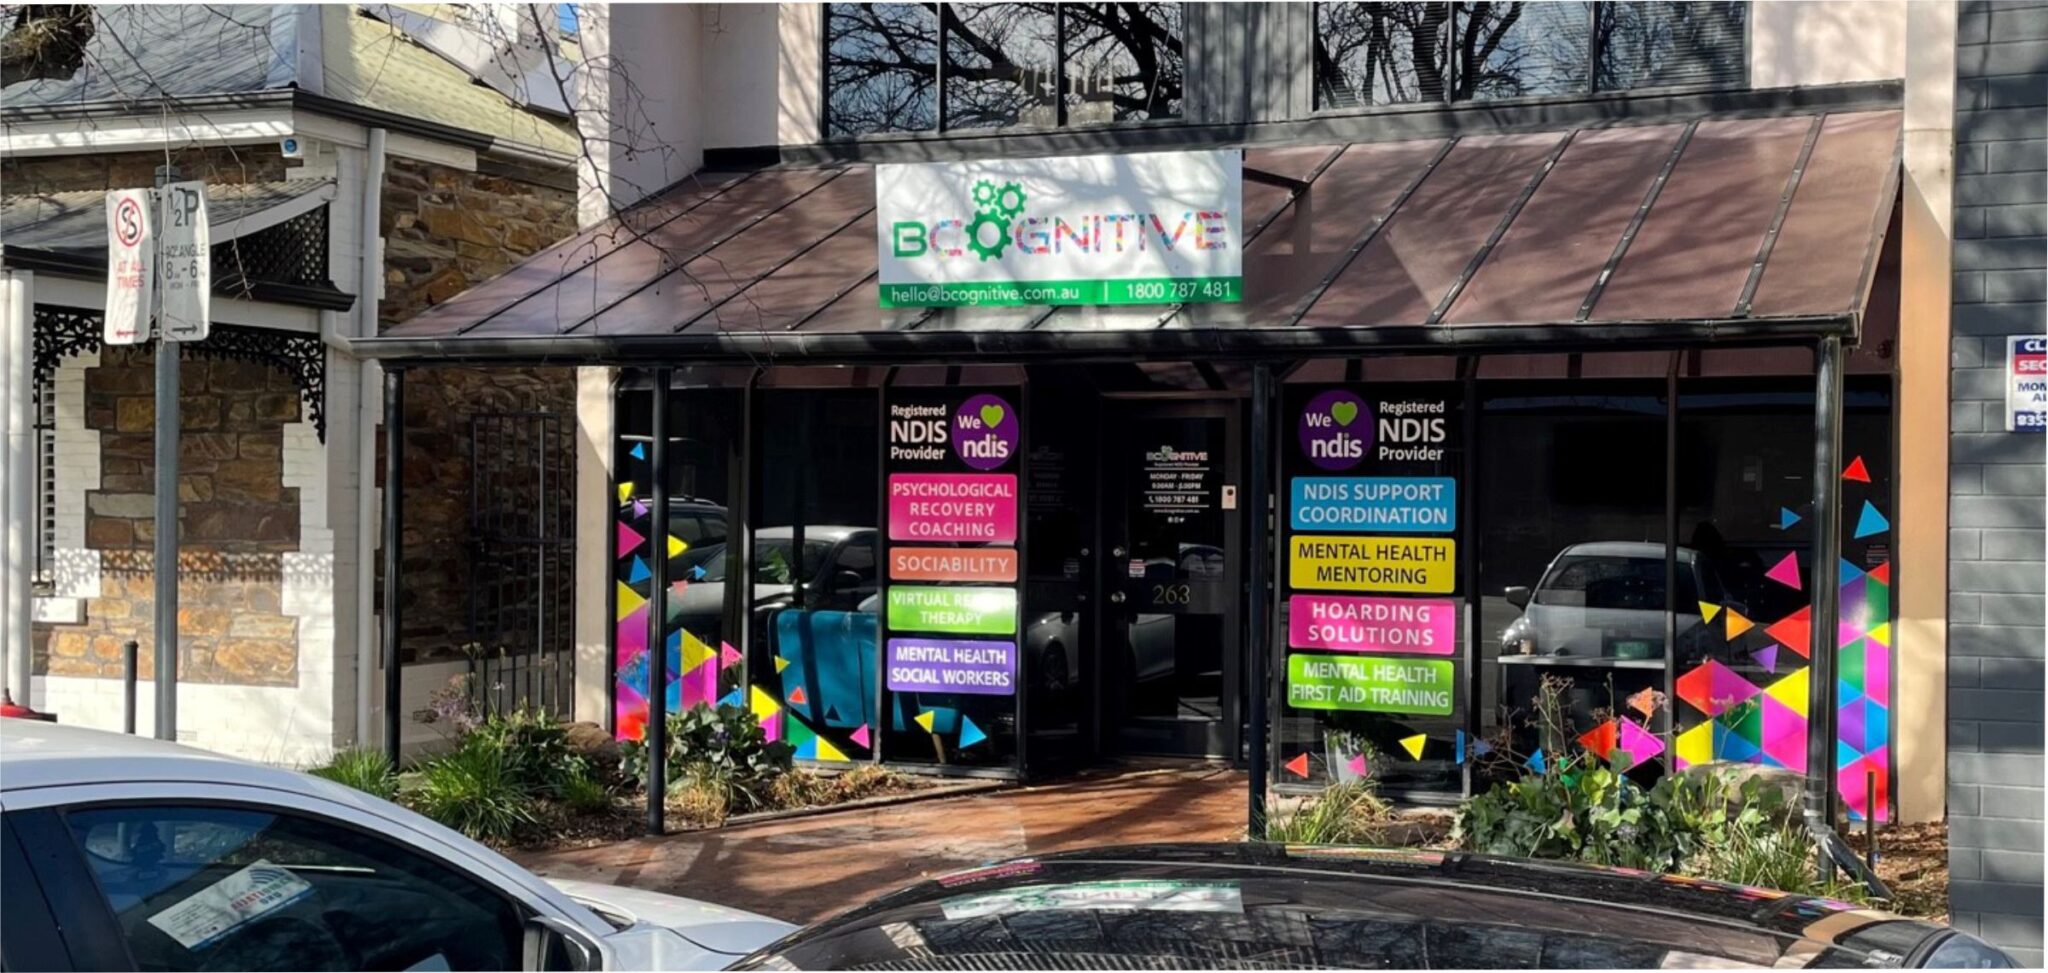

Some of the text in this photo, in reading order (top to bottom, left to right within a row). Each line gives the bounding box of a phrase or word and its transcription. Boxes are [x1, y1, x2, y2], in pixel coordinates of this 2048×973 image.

[117, 276, 145, 289] TIMES
[891, 281, 1230, 305] hello@bcognitive.com.au 1800 787 481
[890, 404, 947, 419] Registered
[1379, 401, 1445, 416] Registered
[957, 415, 981, 429] We
[1306, 413, 1332, 427] We
[890, 420, 947, 443] NDIS
[1379, 418, 1446, 443] NDIS
[890, 446, 946, 460] Provider
[963, 434, 1008, 458] ndis
[1311, 432, 1363, 458] ndis
[1379, 446, 1444, 461] Provider
[892, 482, 1012, 498] PSYCHOLOGICAL
[1303, 484, 1443, 501] NDIS SUPPORT
[909, 502, 996, 517] RECOVERY
[1299, 506, 1448, 525] COORDINATION
[909, 522, 996, 537] COACHING
[1298, 543, 1446, 561] MENTAL HEALTH
[896, 556, 1009, 573] SOCIABILITY
[1316, 566, 1427, 585] MENTORING
[891, 591, 949, 607] VIRTUAL
[1153, 584, 1190, 605] 263
[920, 610, 983, 626] THERAPY
[1312, 602, 1431, 623] HOARDING
[1308, 625, 1434, 647] SOLUTIONS
[896, 646, 1007, 665] MENTAL HEALTH
[892, 668, 1010, 687] SOCIAL WORKERS
[1303, 661, 1437, 684] MENTAL HEALTH
[1291, 684, 1449, 708] FIRST AID TRAINING
